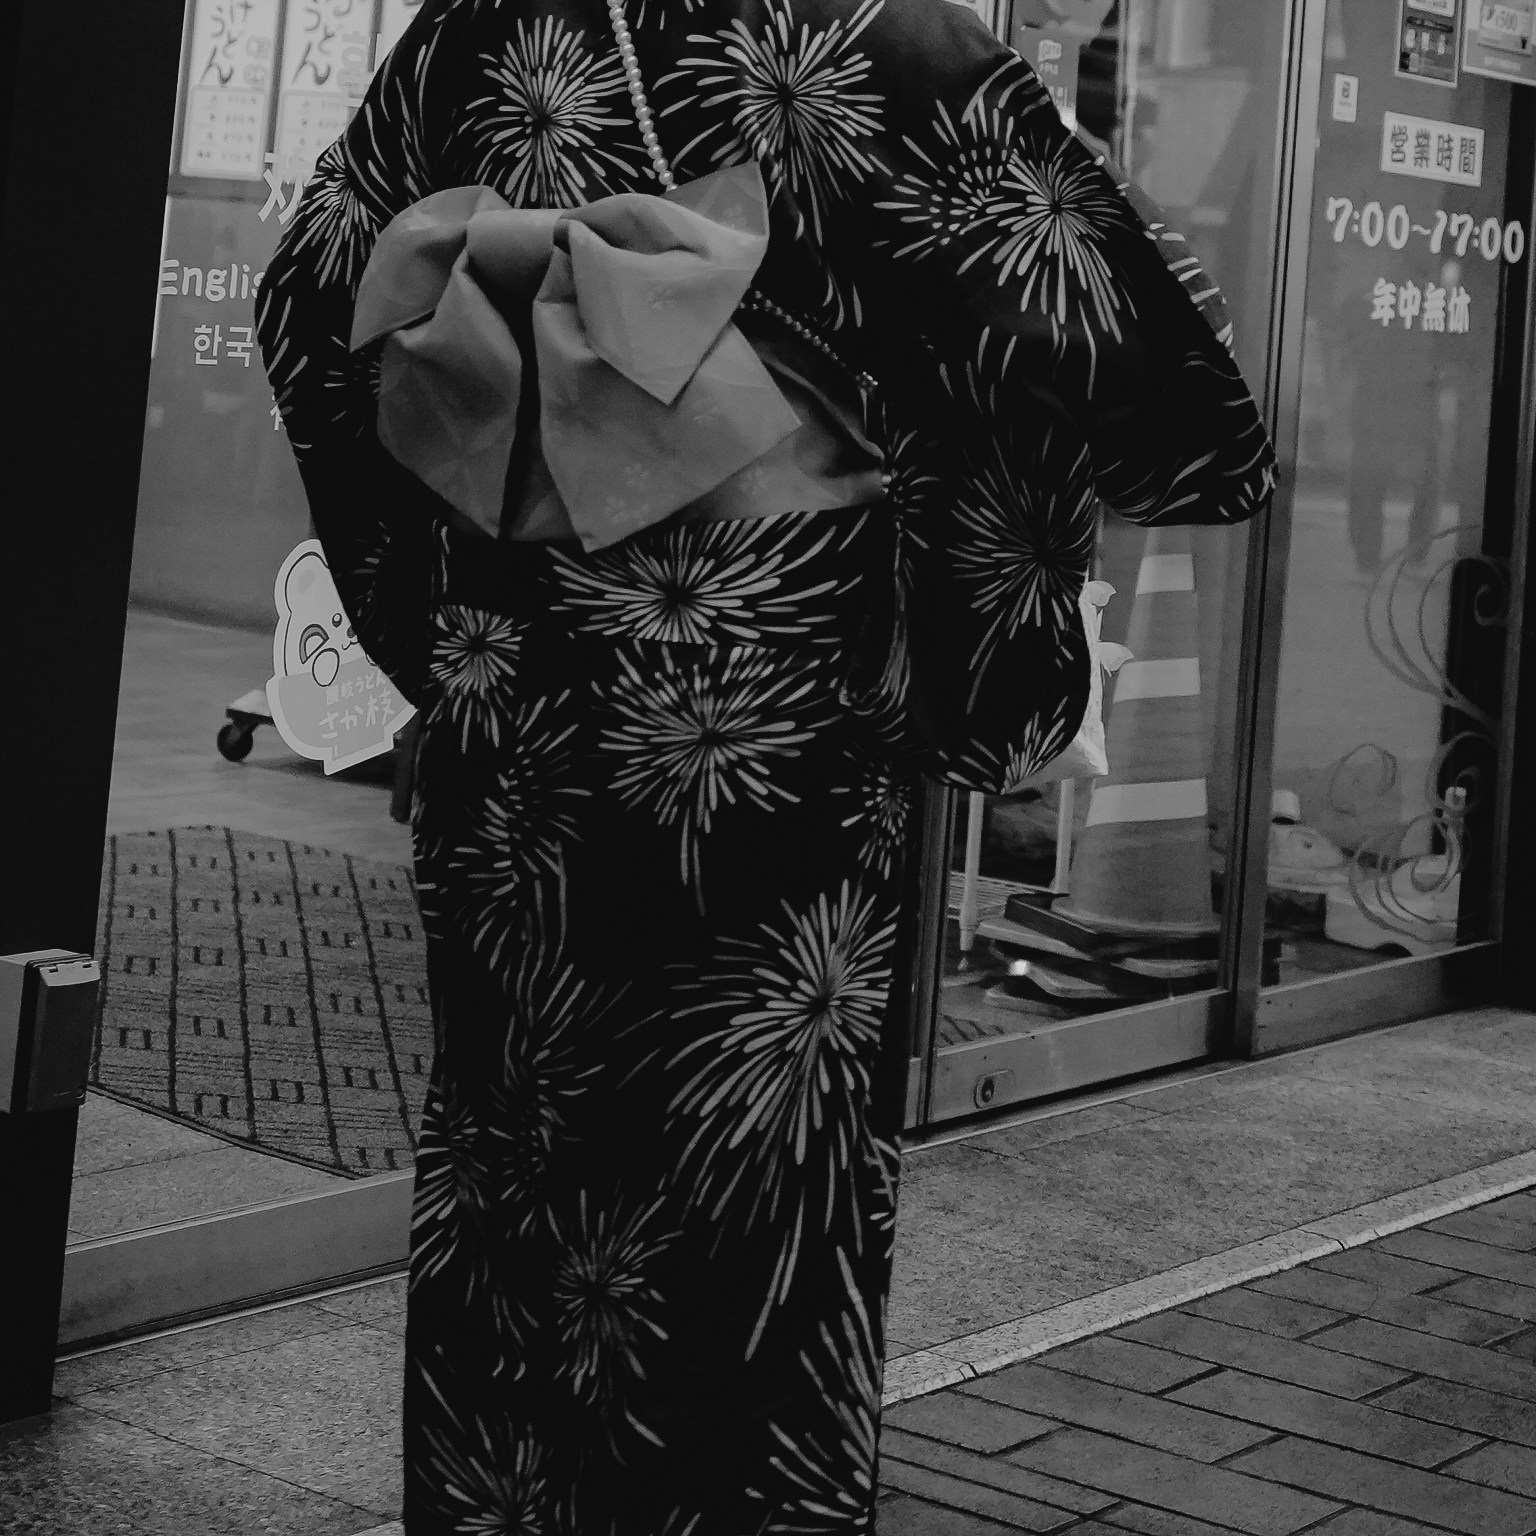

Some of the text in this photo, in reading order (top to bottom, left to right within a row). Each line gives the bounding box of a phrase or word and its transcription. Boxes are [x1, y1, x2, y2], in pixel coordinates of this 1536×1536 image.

[1390, 124, 1477, 175] 営業時間
[1371, 277, 1472, 334] 年中無休
[318, 687, 395, 739] さか枝
